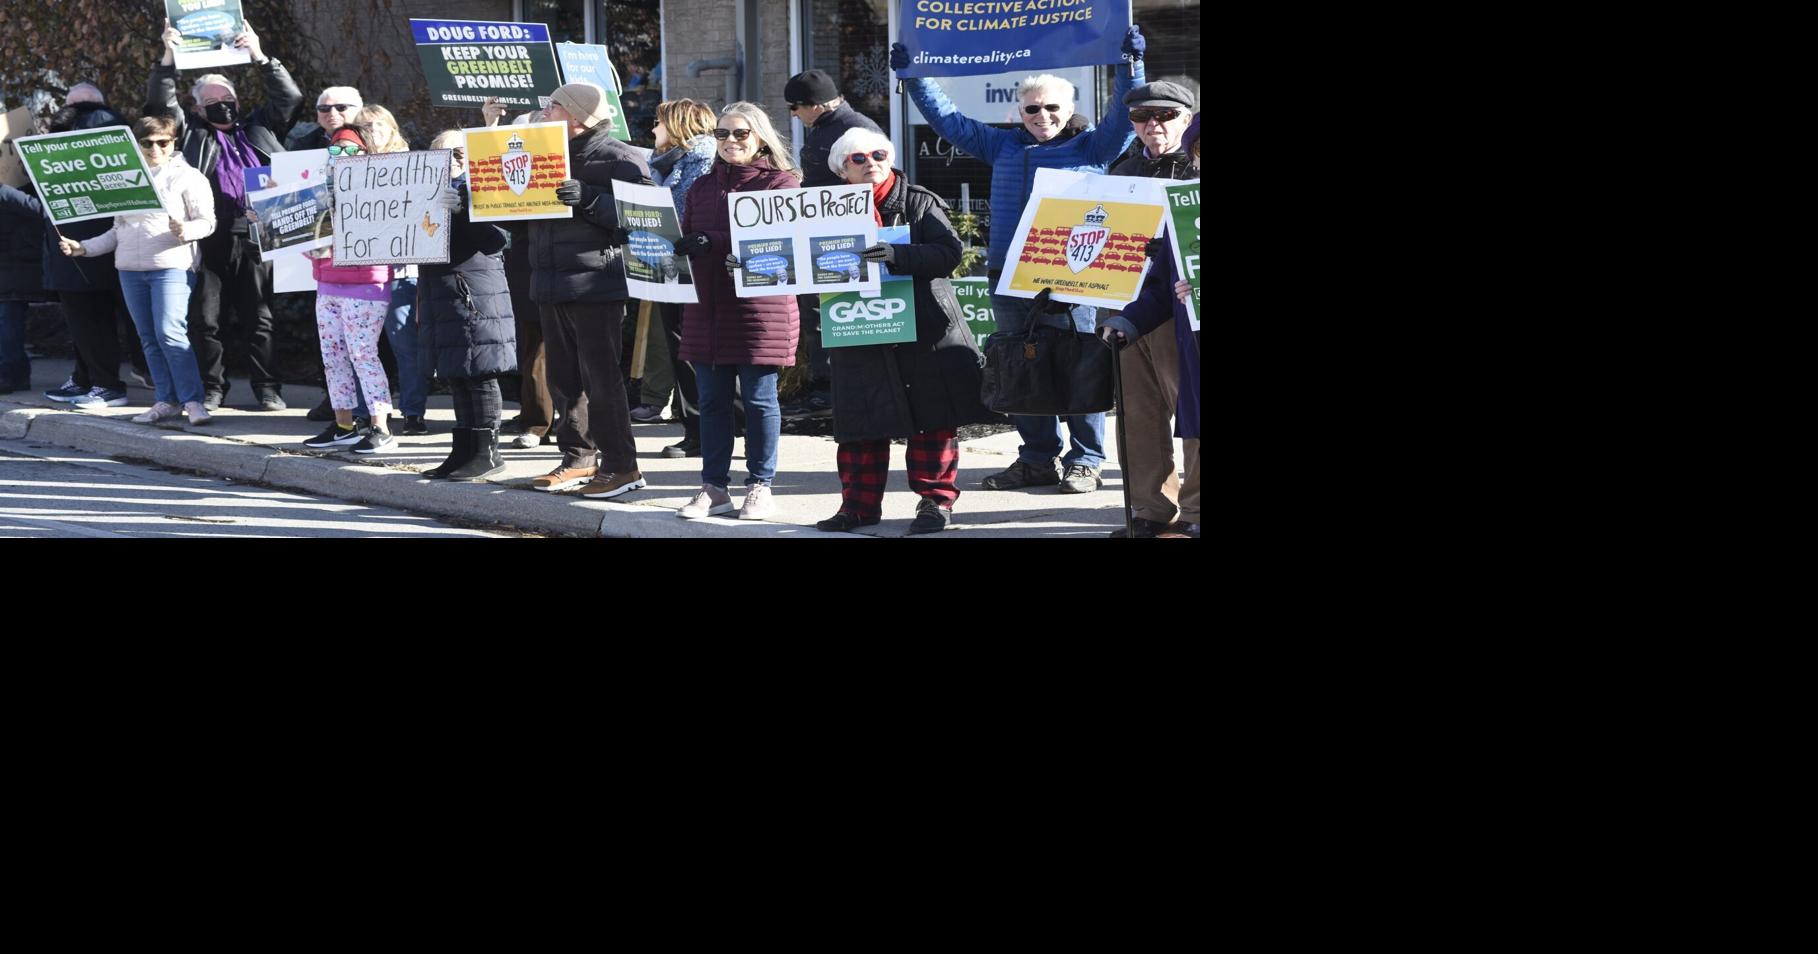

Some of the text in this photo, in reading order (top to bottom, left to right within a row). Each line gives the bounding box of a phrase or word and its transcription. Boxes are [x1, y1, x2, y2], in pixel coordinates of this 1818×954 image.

[917, 0, 1086, 14] COLLECTIVE ACTION
[916, 8, 1094, 32] FOR CLIMATE JUSTICE
[426, 26, 530, 40] DOUG FORD:
[440, 46, 530, 60] KEEP YOUR
[914, 47, 1031, 65] climatereality.ca
[446, 60, 533, 74] GREENBELT
[454, 74, 534, 88] PROMISE!
[22, 143, 42, 154] Tell
[44, 142, 68, 154] your
[70, 132, 130, 149] councillor!
[919, 141, 930, 156] A
[40, 152, 128, 174] Save Our
[504, 154, 528, 174] STOP
[100, 173, 124, 182] 5000
[104, 180, 128, 190] acres
[338, 154, 444, 200] a healthy
[510, 168, 526, 185] 413
[40, 178, 101, 197] Farms
[1170, 190, 1200, 206] Tell
[272, 206, 318, 230] HANDS OFF THE
[340, 190, 412, 233] planet
[734, 196, 796, 228] OURS
[820, 190, 872, 218] PROTECT
[279, 215, 315, 234] GREENBELT!
[626, 217, 662, 228] YOU LIED!
[343, 224, 416, 260] for all
[837, 242, 854, 250] LIED!
[1070, 230, 1106, 248] STOP
[1071, 244, 1094, 262] 413
[952, 285, 973, 296] Tell
[1088, 282, 1110, 290] ASPHALT
[828, 298, 906, 323] GASP
